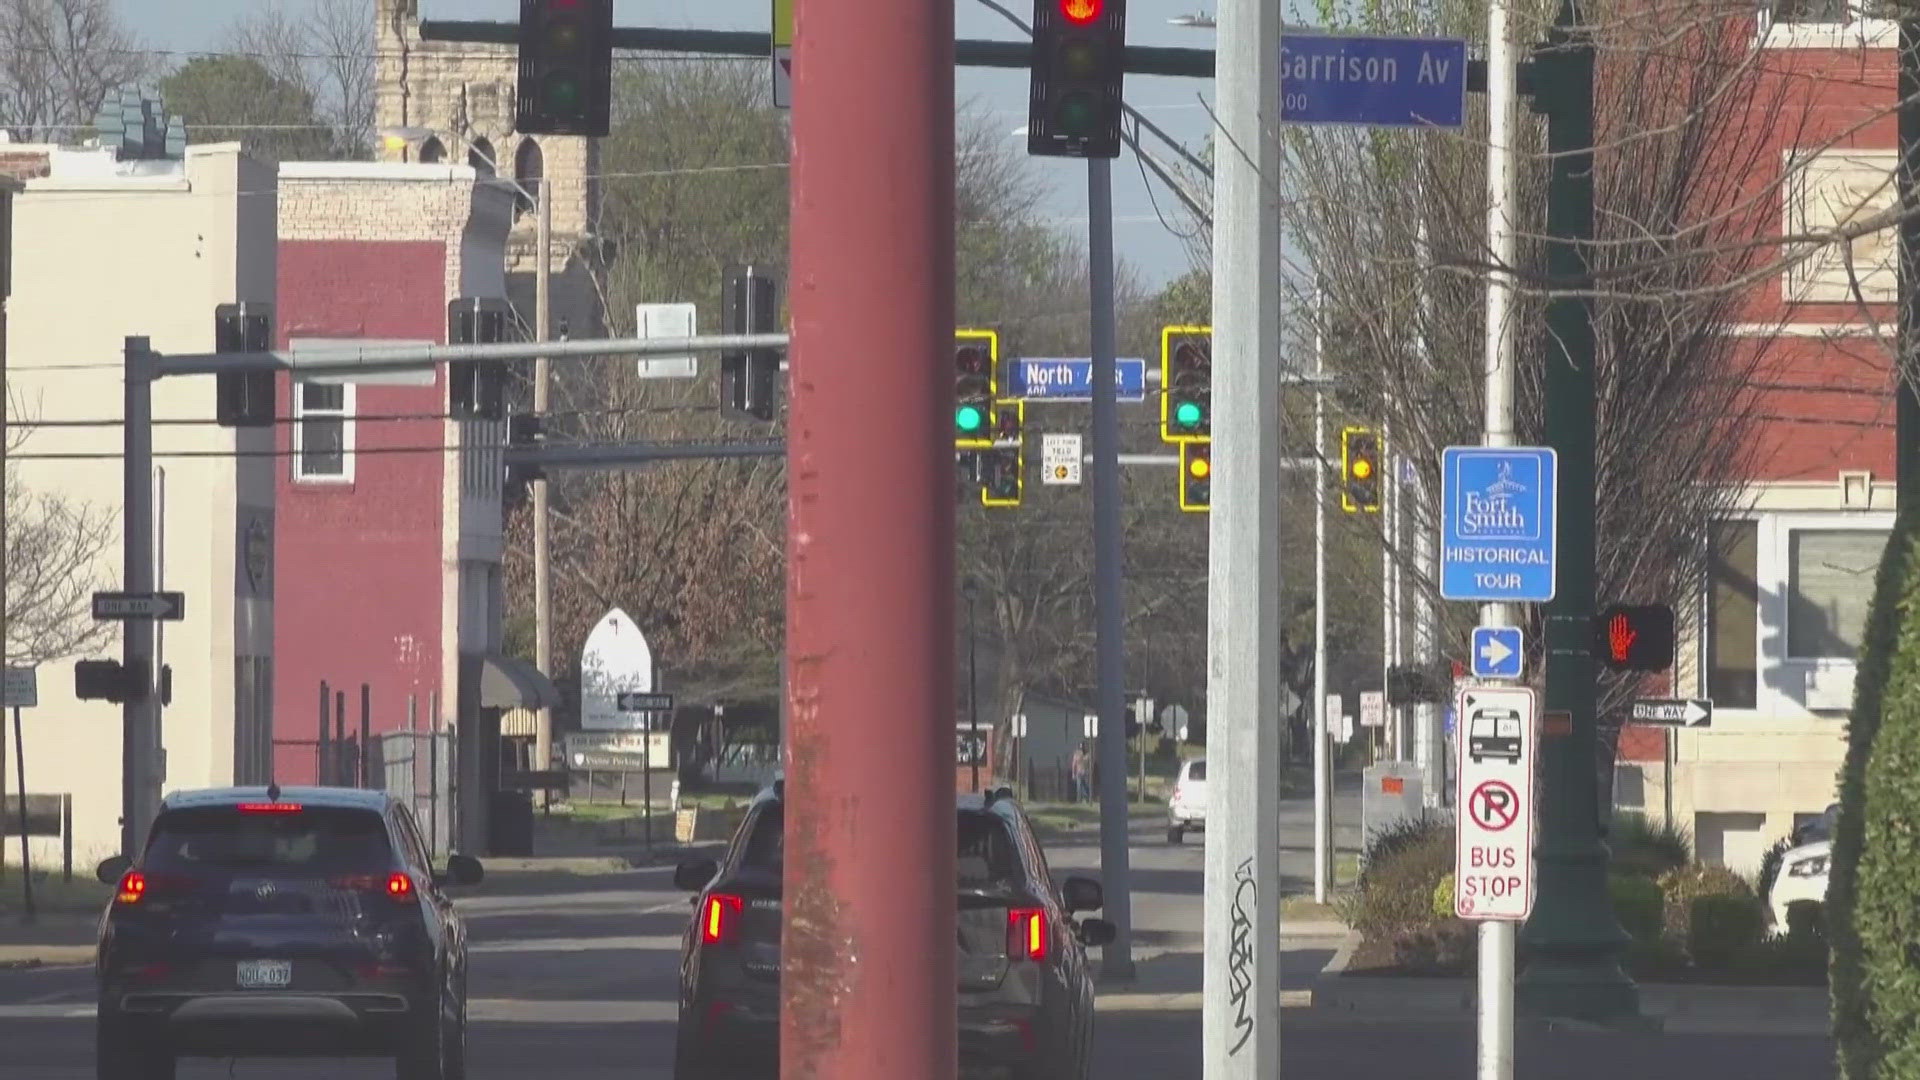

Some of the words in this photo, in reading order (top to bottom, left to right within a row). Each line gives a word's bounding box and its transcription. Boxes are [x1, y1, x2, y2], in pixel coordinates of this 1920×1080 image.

[1417, 51, 1450, 85] Av
[1281, 93, 1307, 111] 00
[1027, 363, 1072, 385] North
[1465, 491, 1507, 513] Fort
[1463, 505, 1525, 534] Smith
[1446, 546, 1549, 565] HISTORICAL
[1474, 573, 1522, 589] TOUR
[128, 601, 148, 611] WAY
[1636, 704, 1659, 719] ONE
[1663, 704, 1685, 718] WAY
[1471, 847, 1516, 868] BUS
[1465, 876, 1522, 897] STOP
